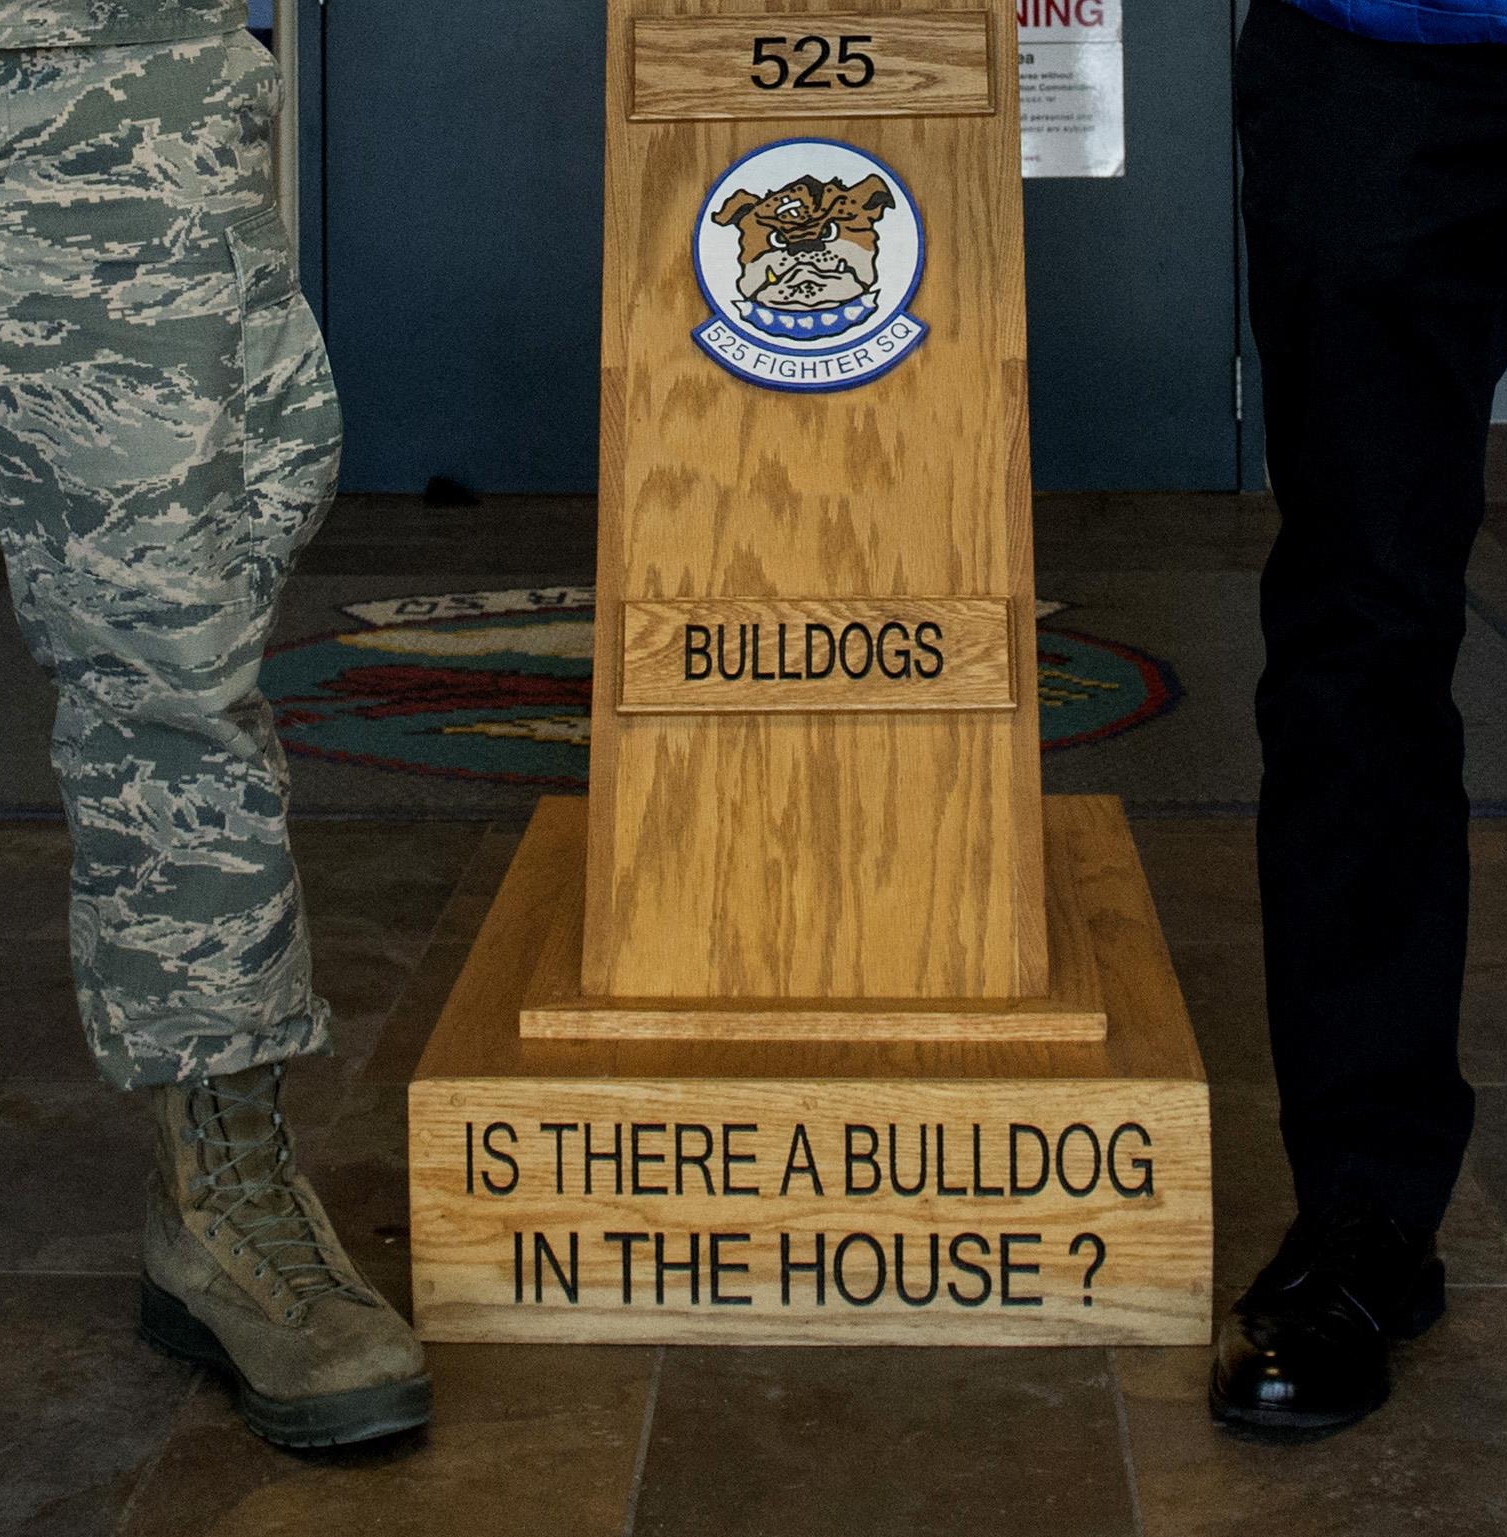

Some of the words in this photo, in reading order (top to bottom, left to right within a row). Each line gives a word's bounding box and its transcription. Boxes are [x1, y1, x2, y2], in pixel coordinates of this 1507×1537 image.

[750, 35, 875, 90] 525
[706, 325, 750, 362] 525
[752, 348, 875, 379] FIGHTER
[875, 322, 914, 353] SQ
[684, 621, 944, 681] BULLDOGS
[466, 1122, 520, 1196] IS
[540, 1122, 760, 1196] THERE
[779, 1123, 824, 1196] A
[845, 1122, 1154, 1198] BULLDOG
[514, 1231, 579, 1304] IN
[604, 1232, 753, 1305] THE
[780, 1231, 1044, 1307] HOUSE
